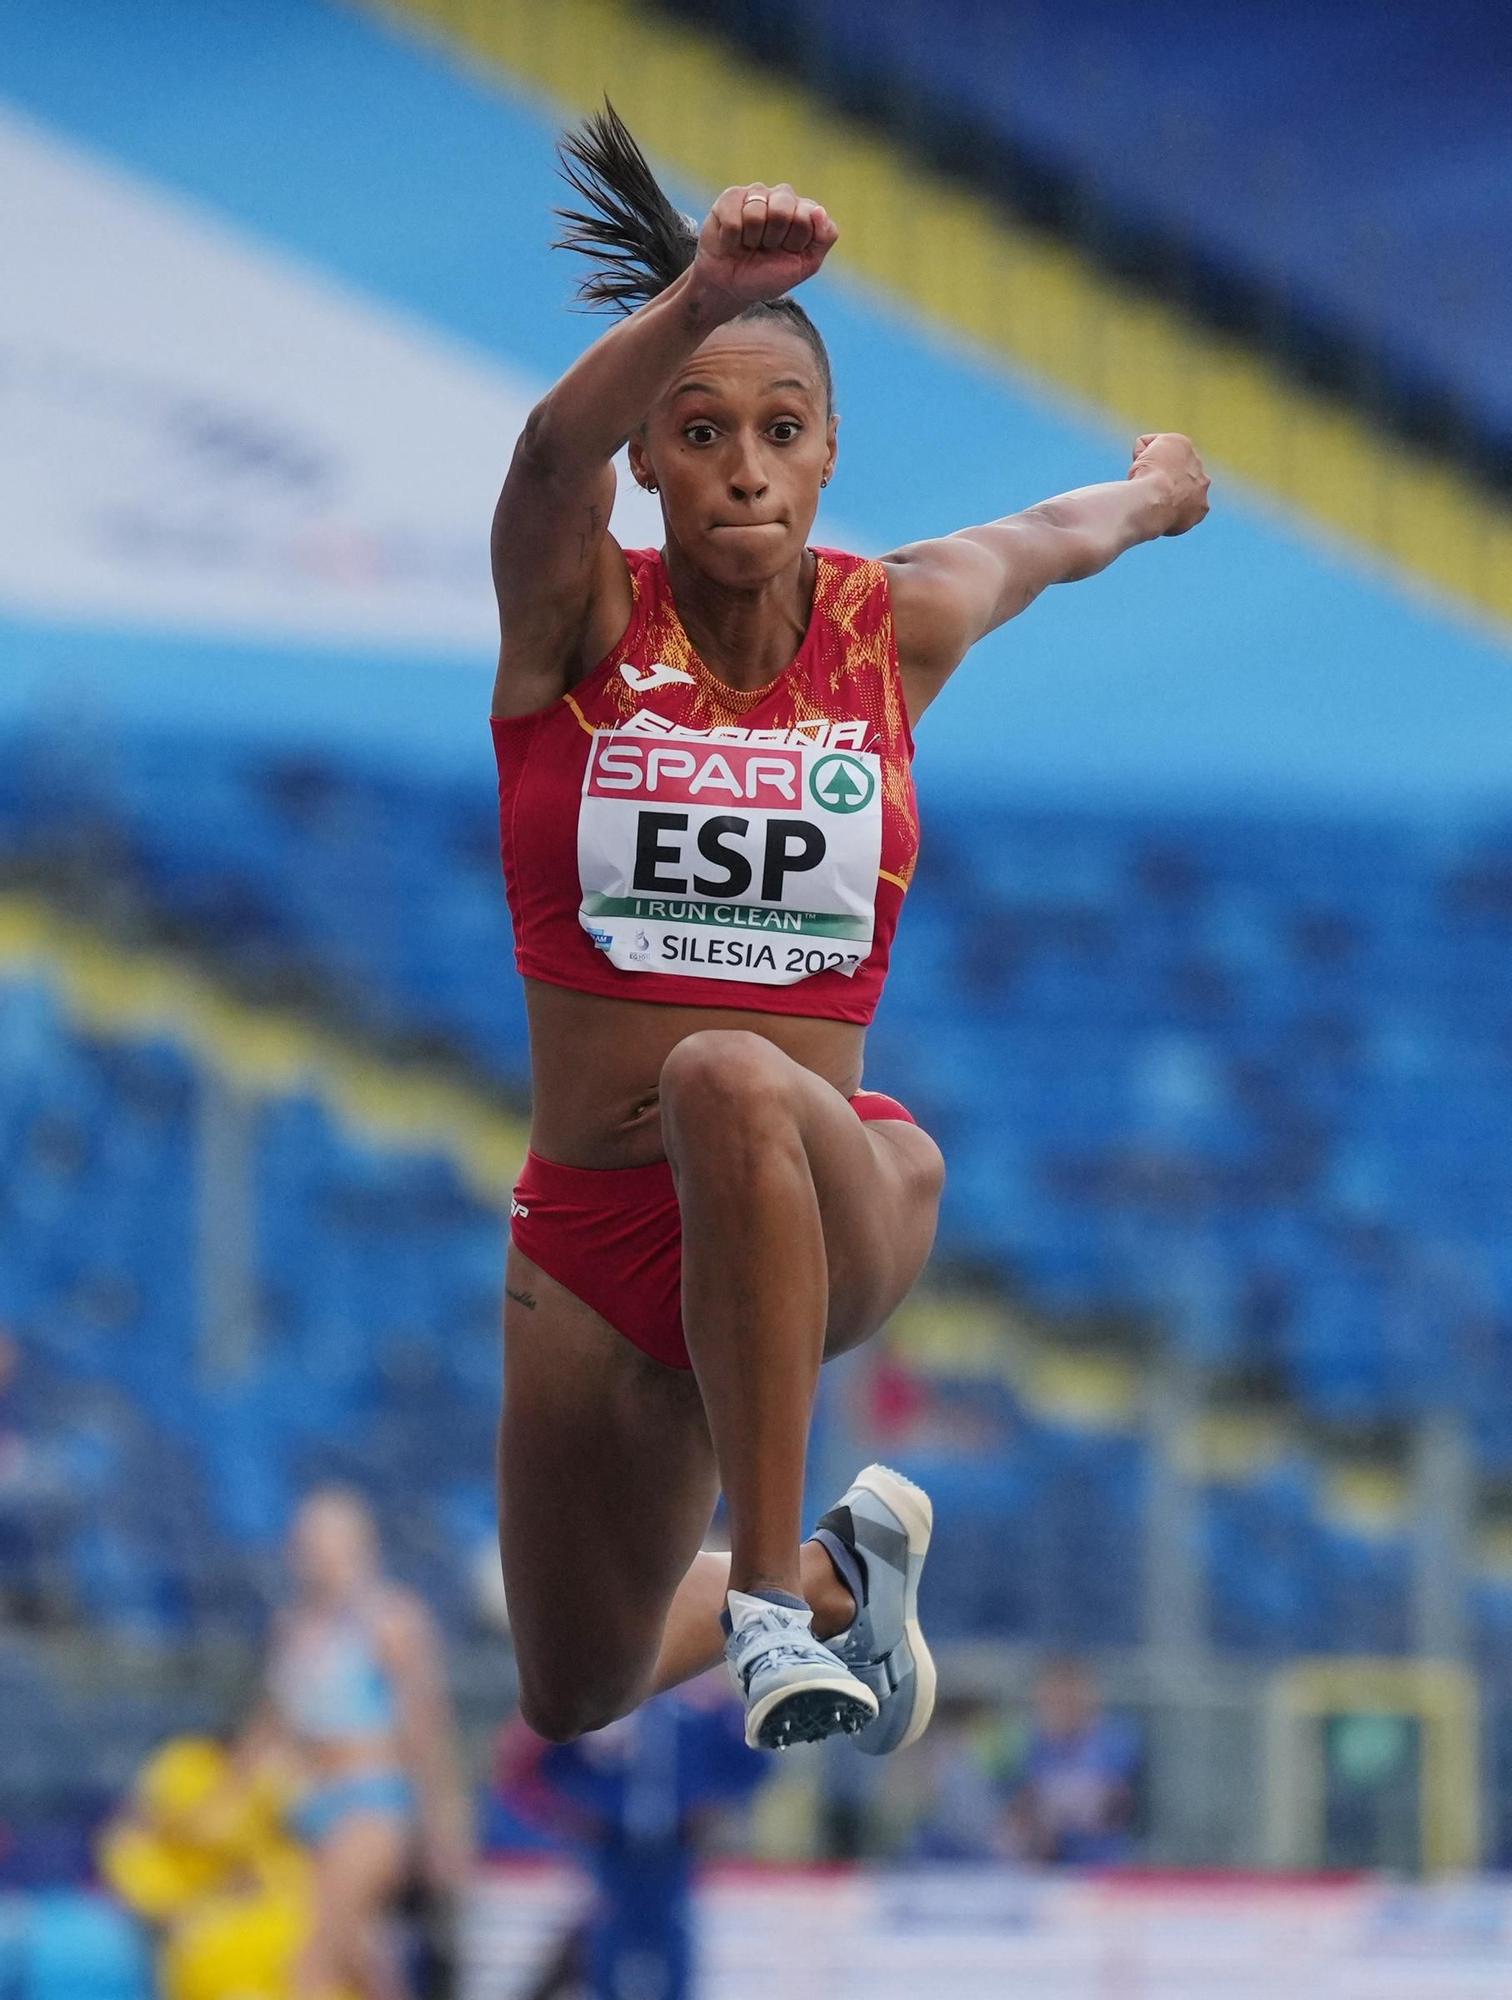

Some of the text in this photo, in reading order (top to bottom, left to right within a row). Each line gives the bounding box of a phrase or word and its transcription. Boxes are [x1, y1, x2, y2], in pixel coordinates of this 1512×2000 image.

[595, 745, 797, 800] SPAR
[633, 810, 827, 902] ESP
[635, 900, 641, 915] I
[648, 901, 707, 921] RUN
[661, 934, 777, 970] SILESIA
